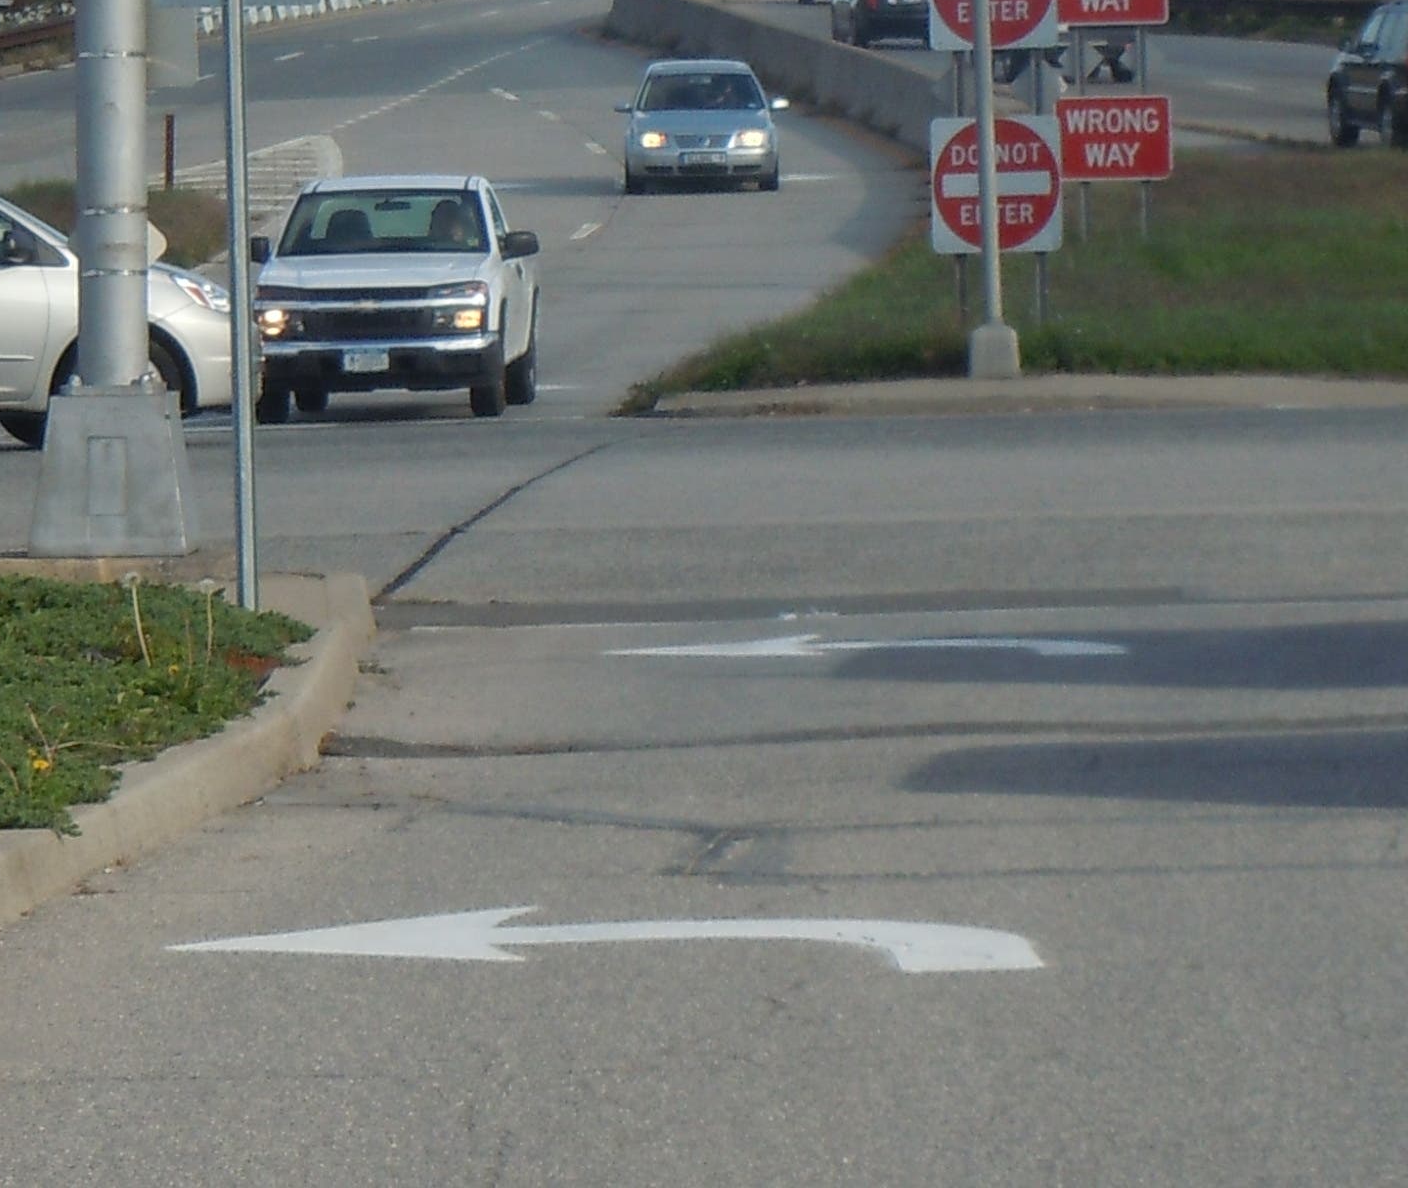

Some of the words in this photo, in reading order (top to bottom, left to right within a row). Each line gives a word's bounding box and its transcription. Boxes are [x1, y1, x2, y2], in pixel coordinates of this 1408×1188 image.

[957, 0, 1029, 23] ETER
[1066, 108, 1160, 134] WRONG
[995, 142, 1040, 164] NOT
[1085, 141, 1140, 168] WAY
